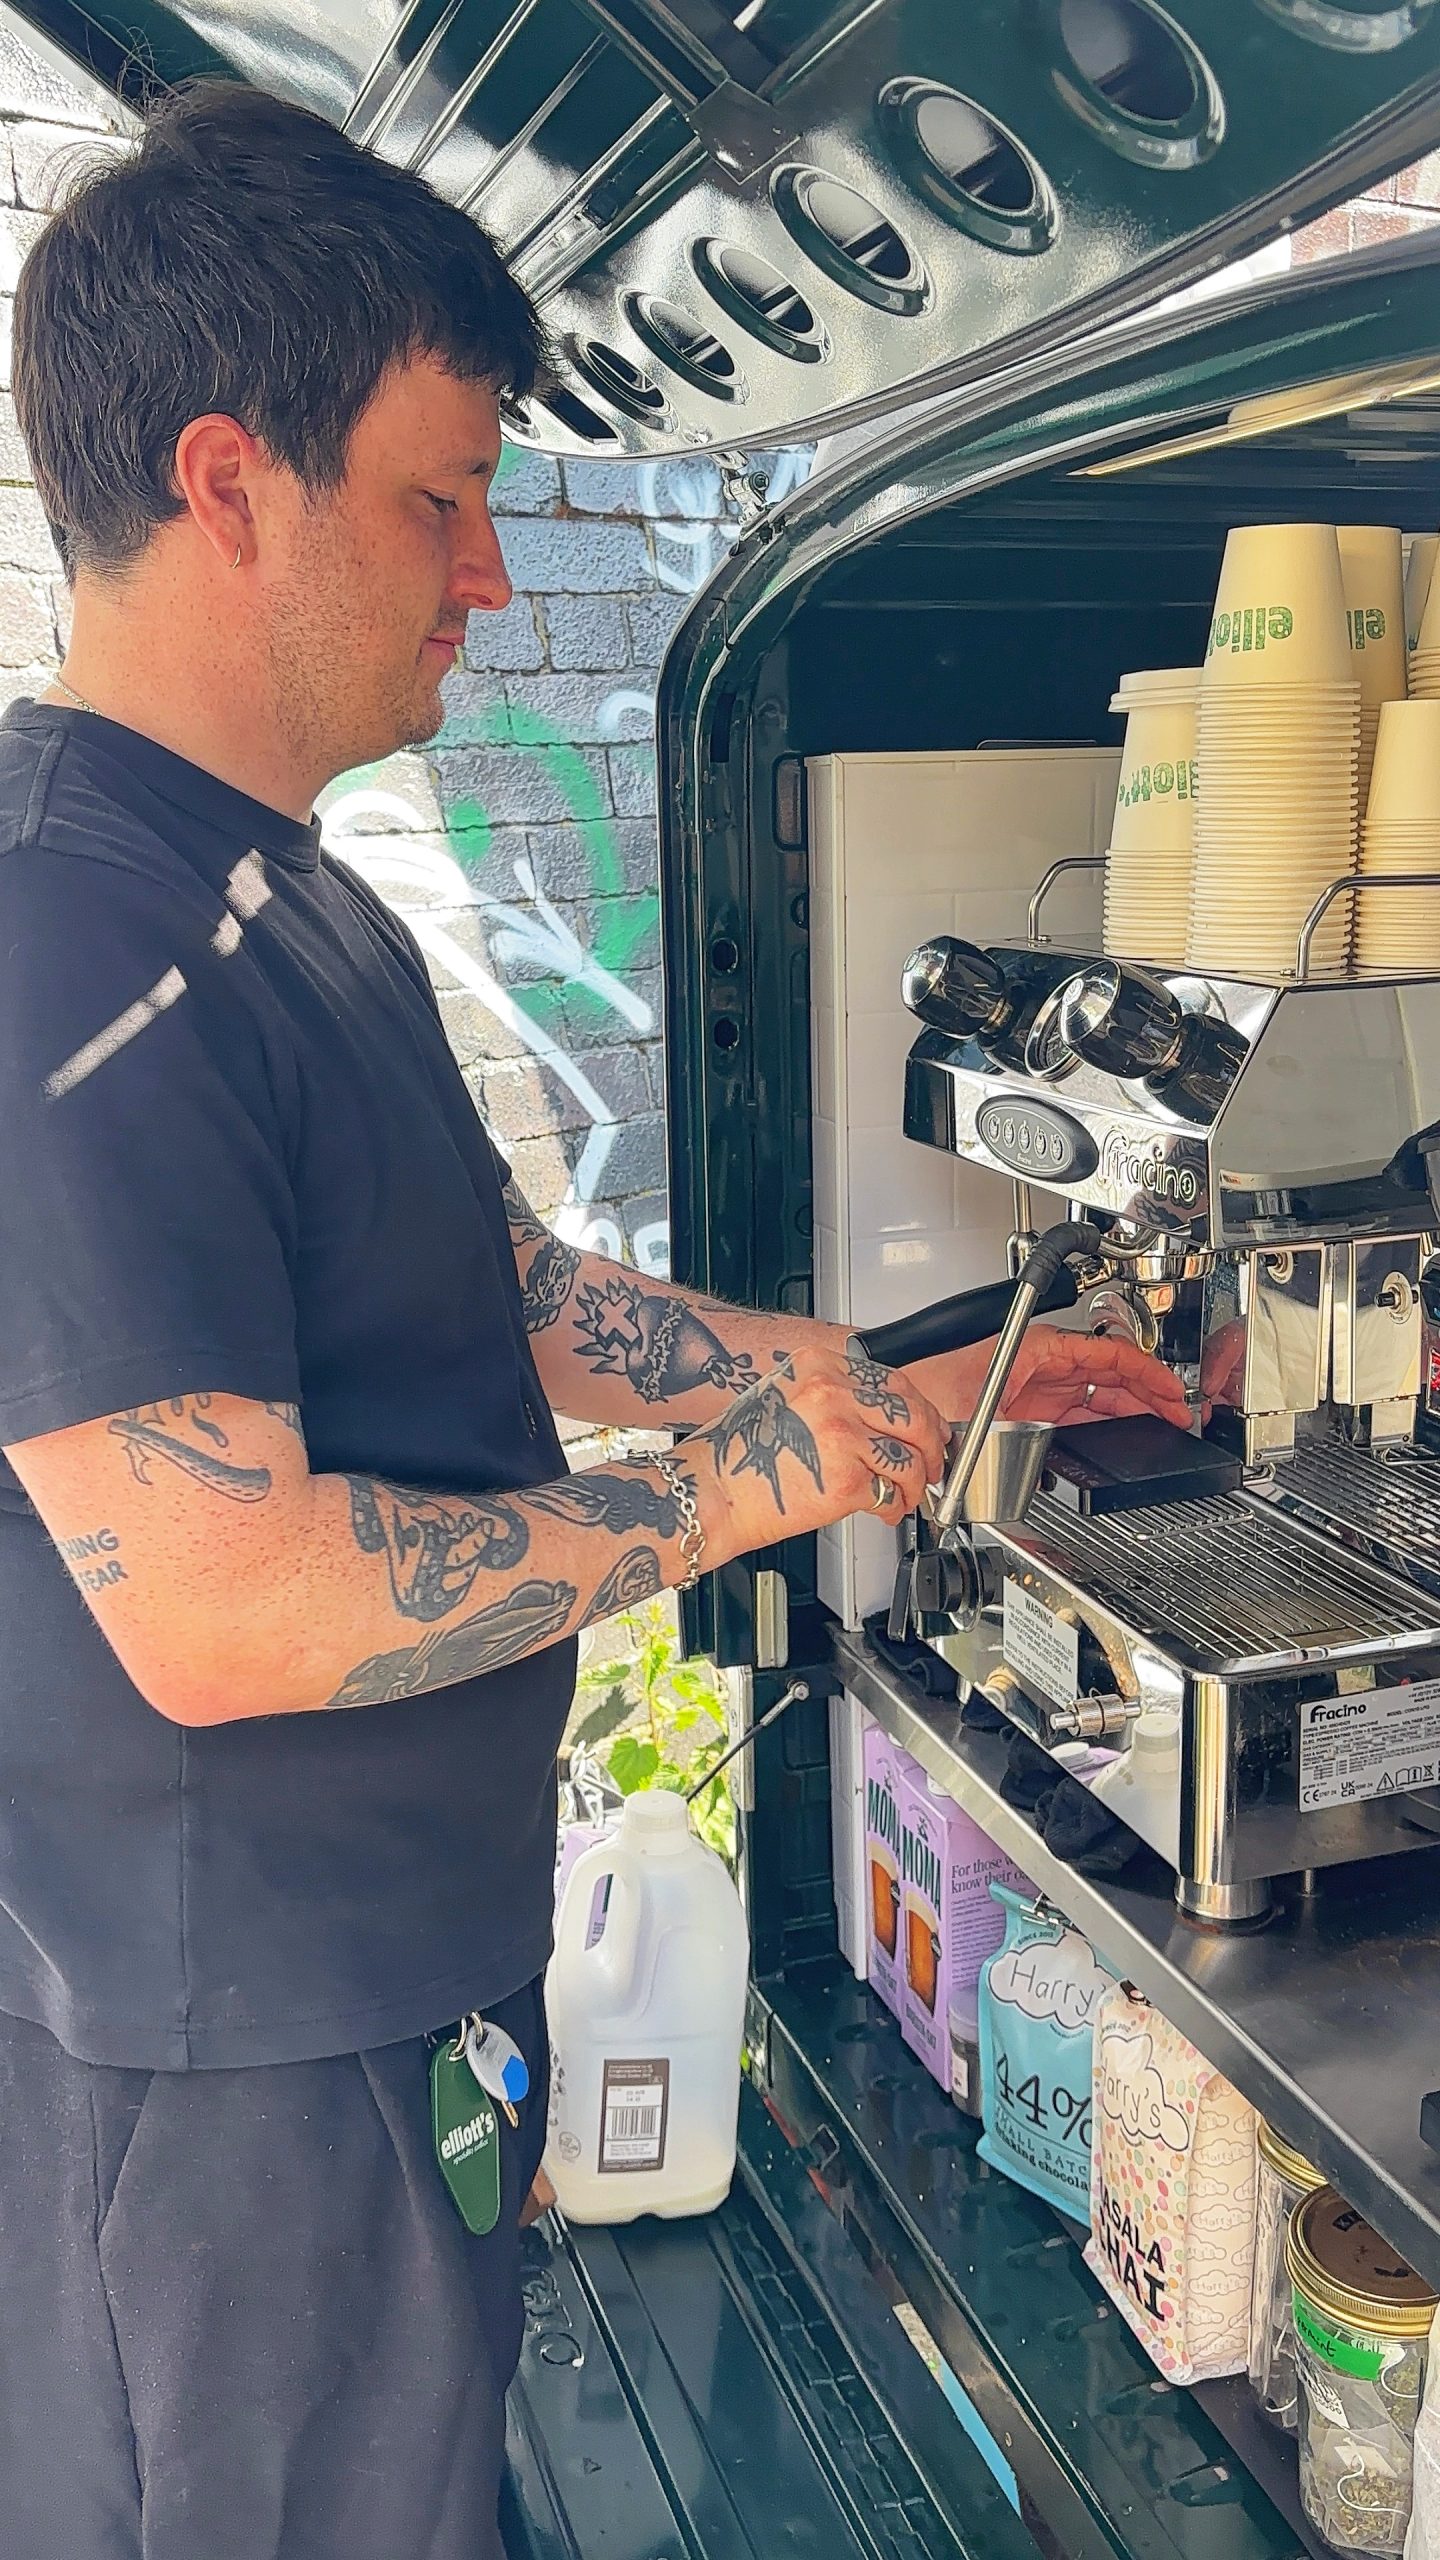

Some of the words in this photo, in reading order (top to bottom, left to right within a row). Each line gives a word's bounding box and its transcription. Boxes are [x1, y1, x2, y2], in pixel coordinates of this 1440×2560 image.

[1024, 1596, 1053, 1629] WARNING
[1340, 1779, 1355, 1790] UK
[1341, 1787, 1355, 1797] CA
[902, 1824, 942, 1922] MOMA
[951, 1865, 971, 1879] For
[973, 1858, 1002, 1874] those
[951, 1877, 982, 1894] know
[1010, 1959, 1107, 2017] Harry'
[1044, 2147, 1088, 2175] BATC
[1038, 2160, 1090, 2193] chocola
